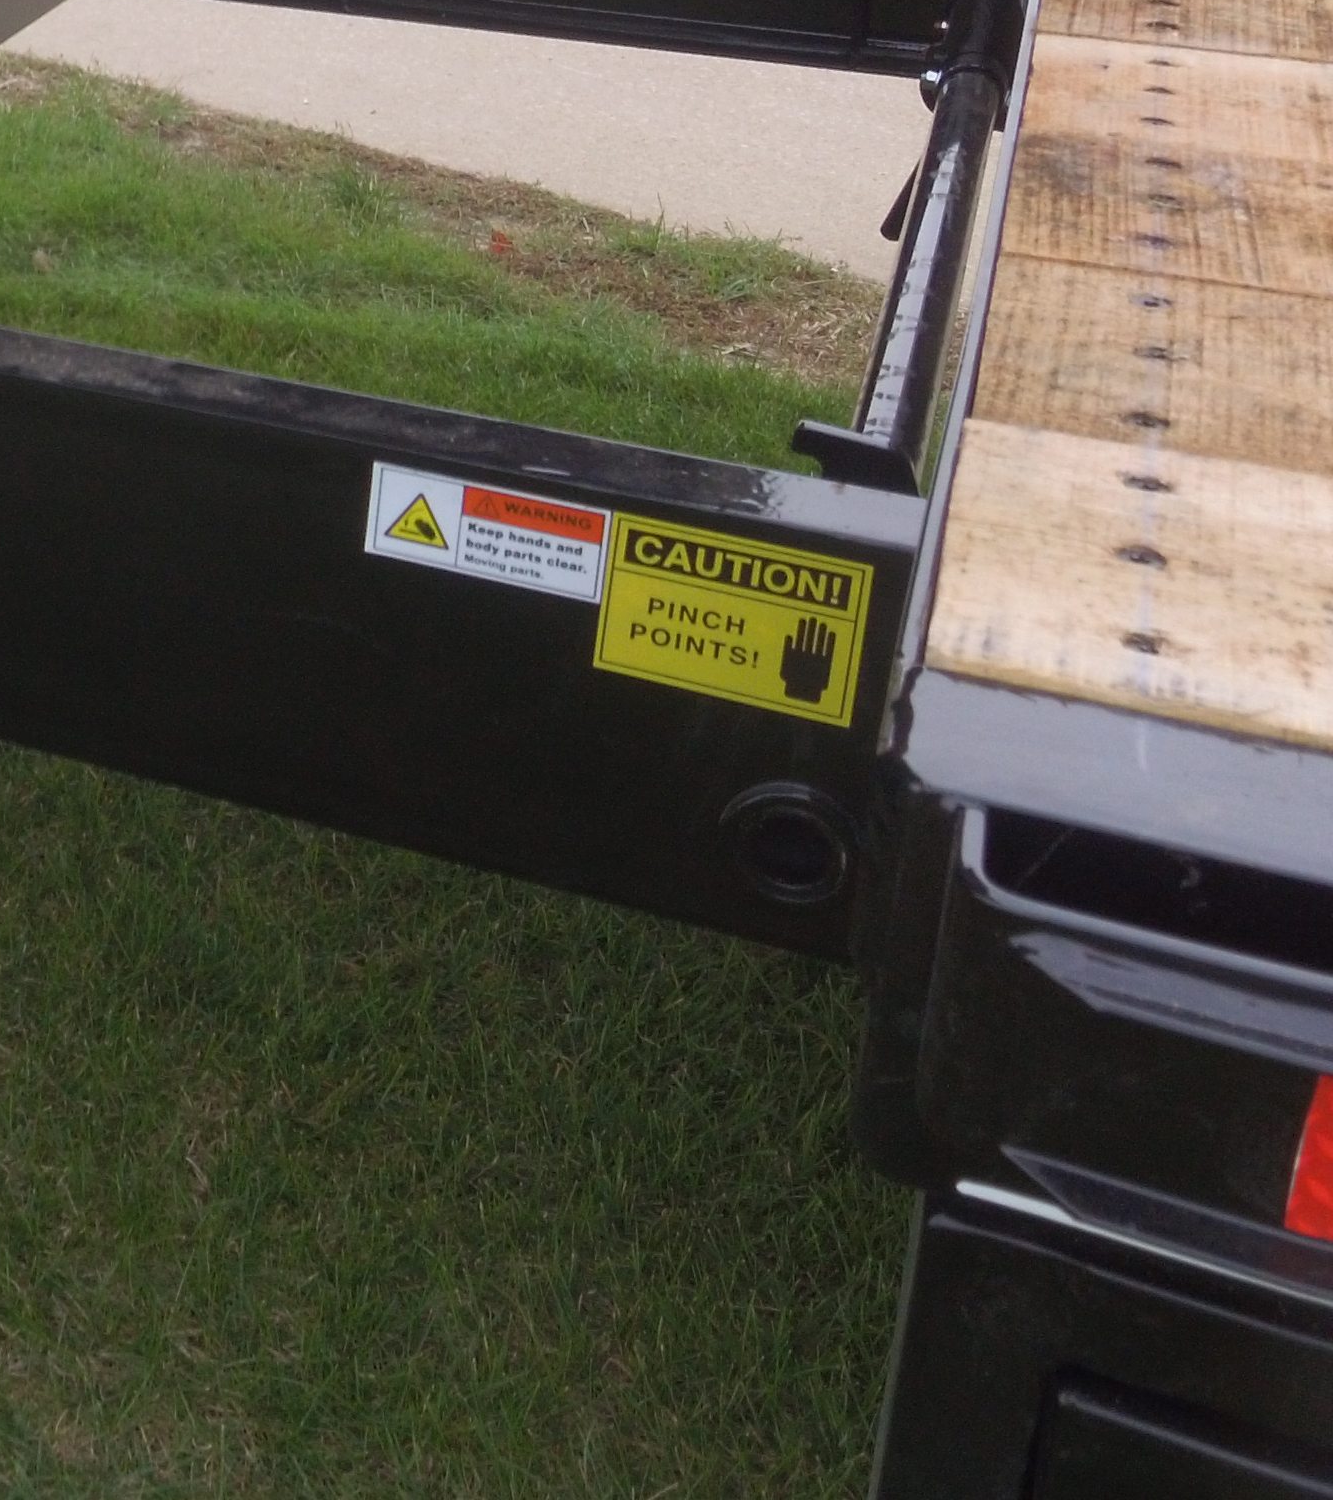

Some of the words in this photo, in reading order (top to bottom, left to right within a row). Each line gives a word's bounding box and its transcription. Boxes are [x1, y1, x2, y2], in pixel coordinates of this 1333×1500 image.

[504, 501, 592, 530] WARNING
[466, 538, 499, 555] body
[504, 548, 541, 563] parts
[546, 557, 588, 574] clear.
[468, 522, 504, 539] Keep
[508, 531, 551, 549] hands
[557, 543, 583, 556] and
[464, 554, 506, 571] Moving
[634, 535, 842, 605] CAUTION!
[648, 597, 745, 636] PINCH
[629, 622, 759, 668] POINTS!
